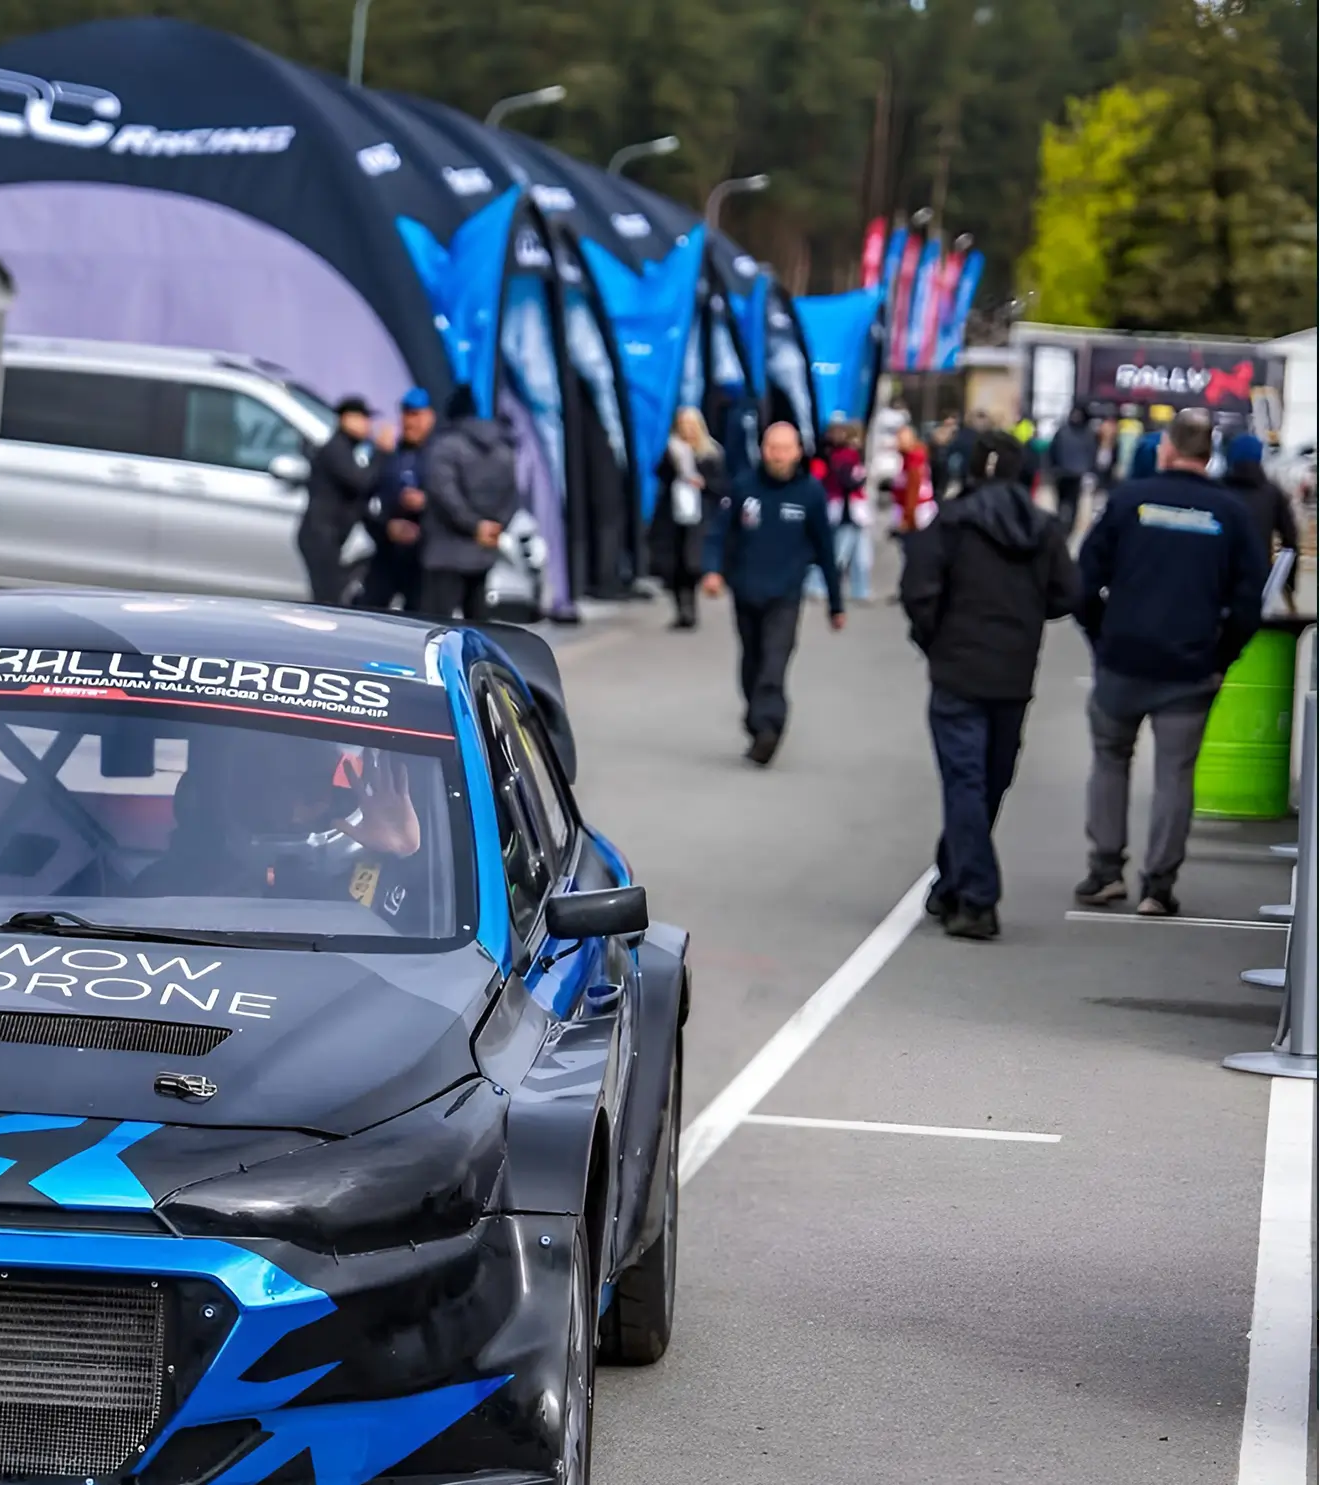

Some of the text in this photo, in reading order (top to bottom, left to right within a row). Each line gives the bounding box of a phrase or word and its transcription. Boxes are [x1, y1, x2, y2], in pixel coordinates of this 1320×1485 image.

[53, 675, 151, 690] LITHUANIAN
[154, 681, 258, 700] RALLYCROSS
[262, 692, 389, 718] CHAMPIONSHIP
